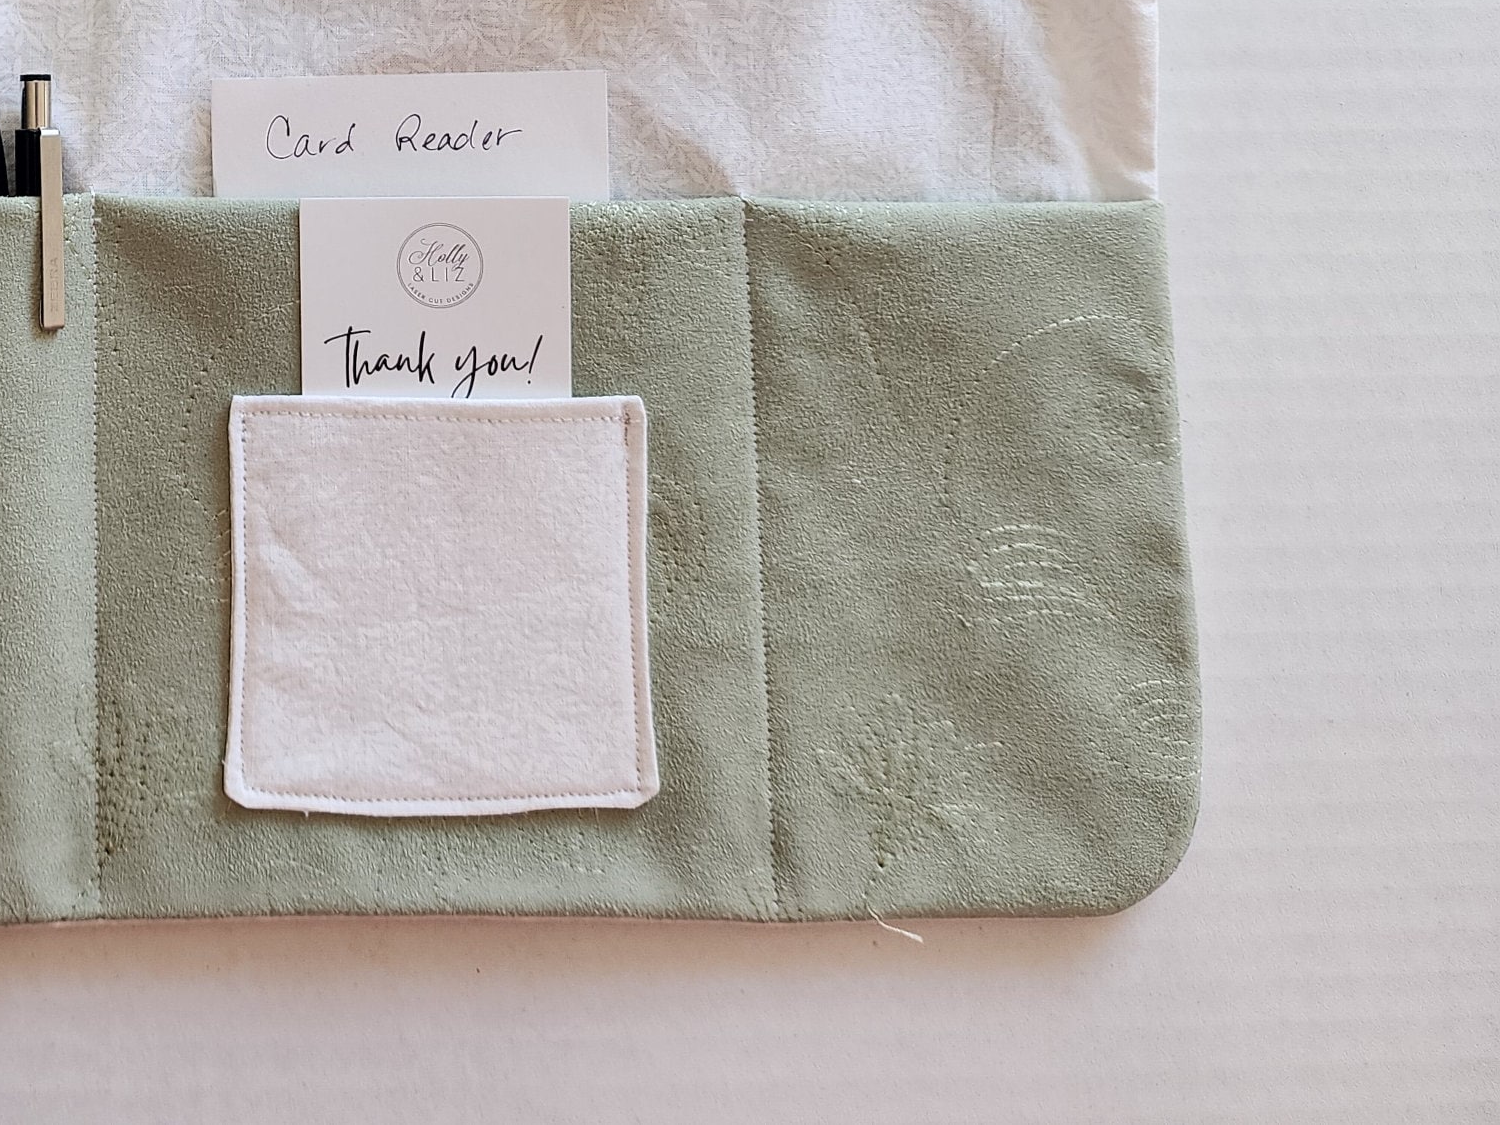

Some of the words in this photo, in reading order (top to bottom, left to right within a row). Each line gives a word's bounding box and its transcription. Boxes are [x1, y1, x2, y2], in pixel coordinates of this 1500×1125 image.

[266, 115, 356, 159] Card
[396, 113, 523, 152] Reader
[408, 238, 469, 271] Holly
[431, 266, 465, 282] LIZ
[408, 283, 426, 300] LASER
[446, 283, 475, 303] DESIGNS
[323, 326, 436, 388] Thank
[451, 334, 544, 398] you!
